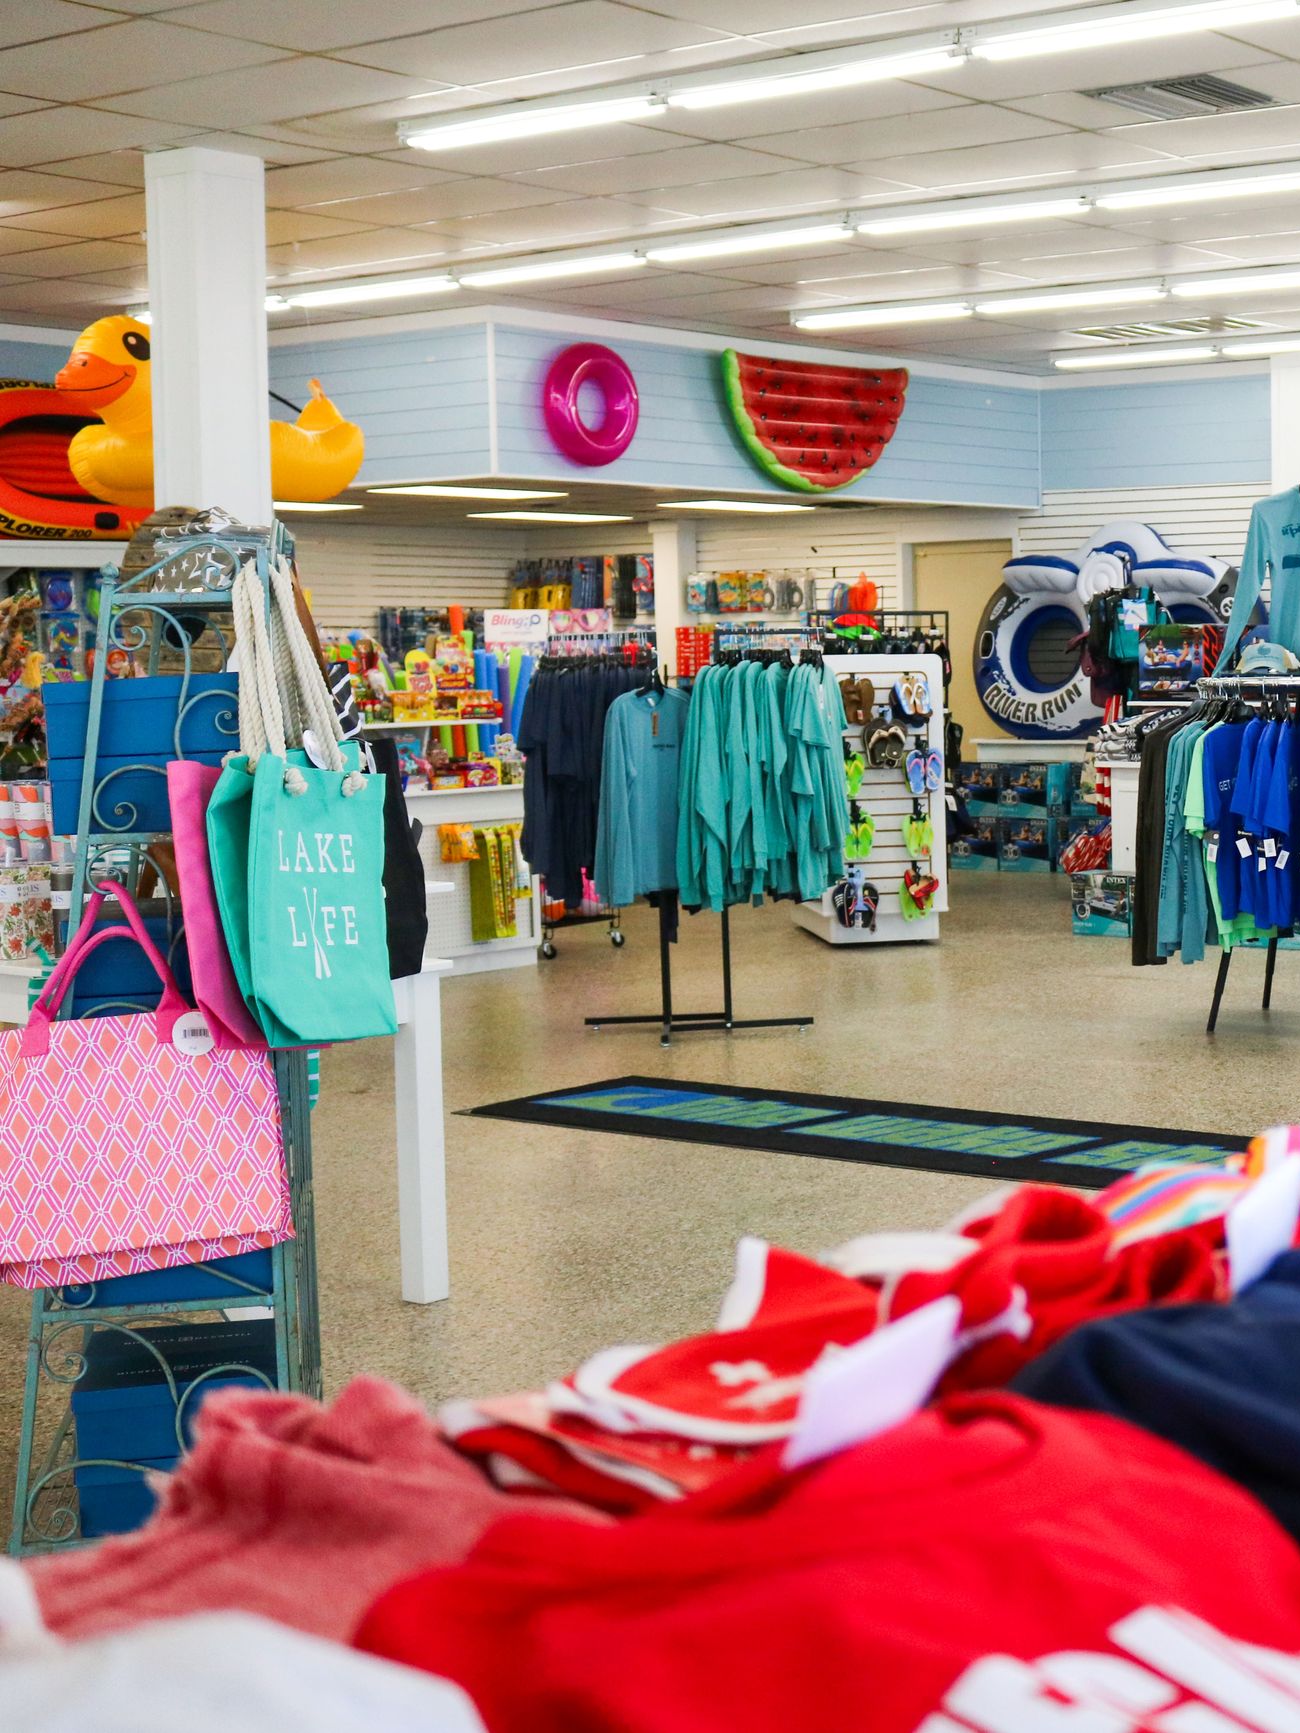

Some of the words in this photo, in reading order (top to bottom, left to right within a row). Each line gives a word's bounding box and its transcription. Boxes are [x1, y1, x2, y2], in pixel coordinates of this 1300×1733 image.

[983, 683, 1037, 723] RIVER
[1041, 683, 1082, 720] RUN
[278, 829, 355, 873] LAKE
